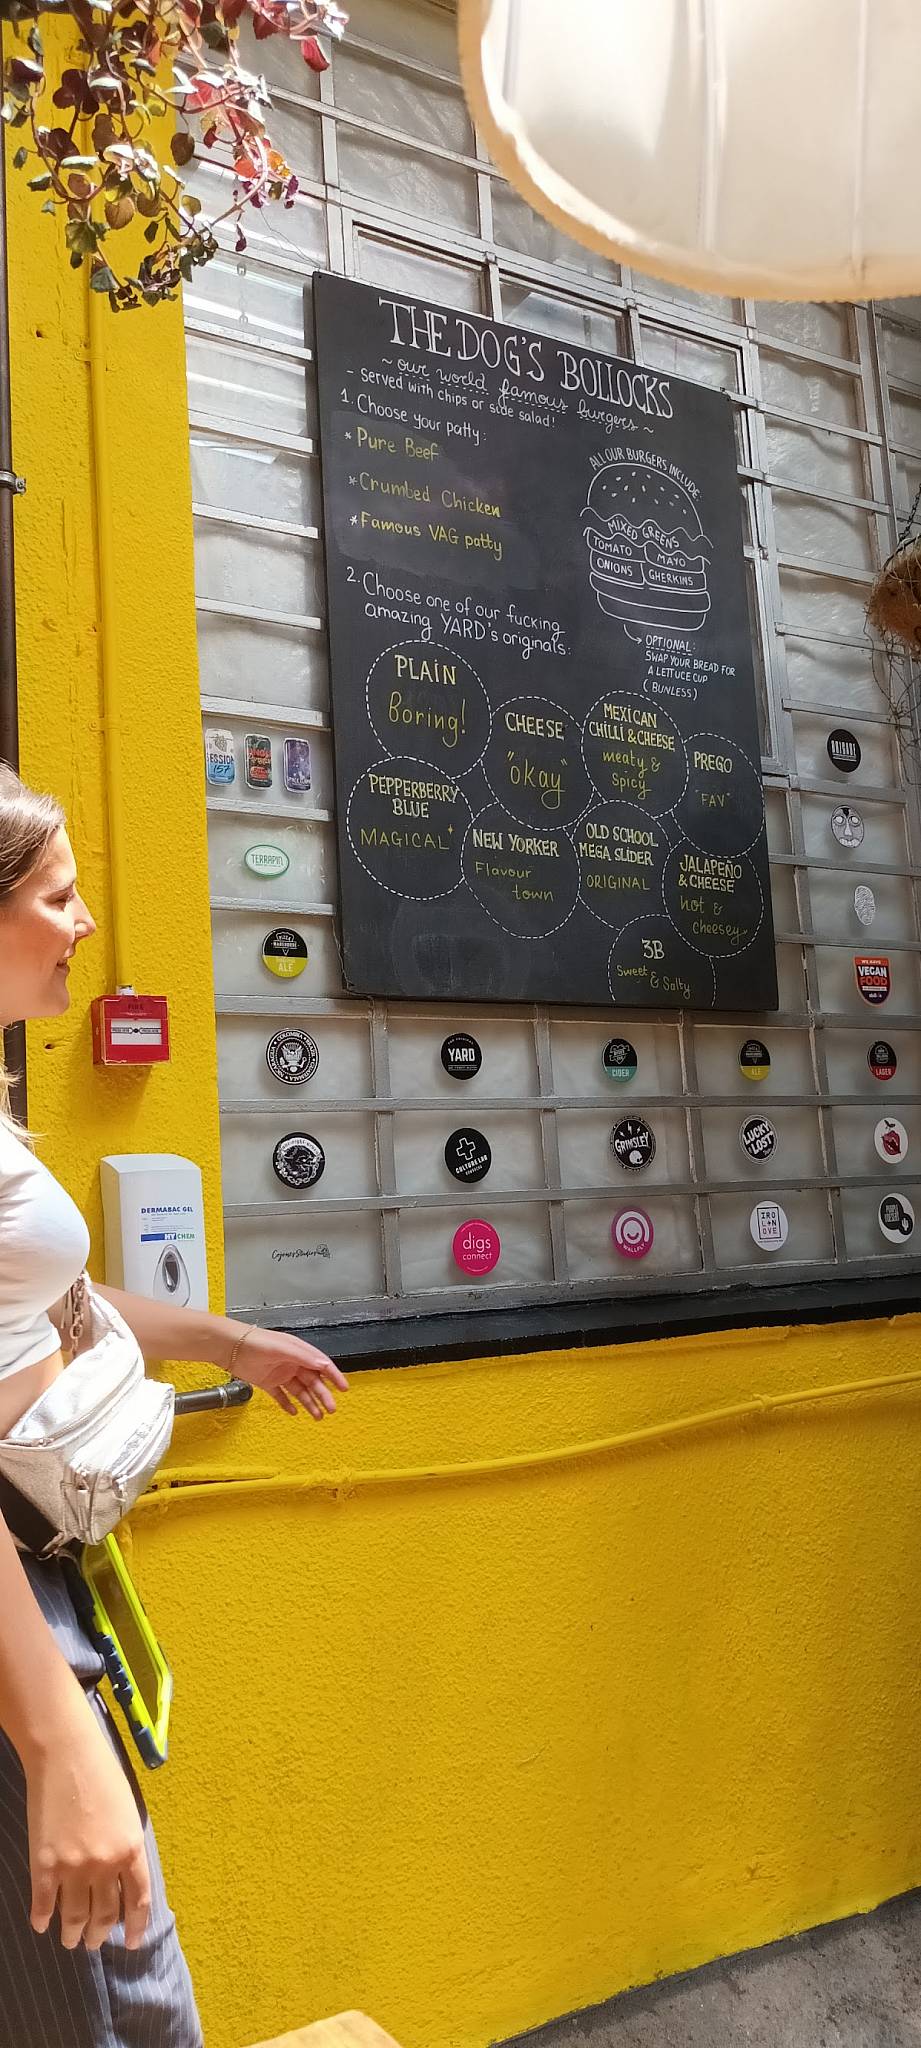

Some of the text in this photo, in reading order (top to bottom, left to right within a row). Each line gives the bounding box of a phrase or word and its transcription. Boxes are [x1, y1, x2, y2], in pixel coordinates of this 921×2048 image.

[378, 297, 674, 418] THE DOG'S BOLLOCKS
[397, 358, 639, 434] our world famous burgers
[408, 381, 434, 399] with
[437, 389, 468, 407] chips
[472, 399, 484, 410] or
[518, 410, 556, 428] salad!
[357, 393, 409, 423] Choose
[413, 412, 442, 432] your
[446, 421, 487, 446] patty:
[356, 426, 441, 462] Pure Beef
[589, 452, 606, 471] ALL
[605, 448, 626, 462] OUR
[627, 448, 668, 471] BURGERS
[359, 473, 501, 518] Crumbed Chicken
[360, 513, 503, 560] Famous VAG patty
[593, 536, 632, 557] TOMATO
[642, 527, 680, 549] GREENS
[597, 557, 633, 577] ONIONS
[656, 553, 686, 568] MAYO
[649, 569, 693, 586] GHERKINS
[346, 566, 565, 639] 2. Choose one of our fucking
[365, 602, 432, 641] amazing
[503, 632, 571, 660] originals:
[645, 651, 736, 676] SWAP YOUR BREAD FOR
[647, 664, 708, 684] A LETTUCE CUP
[388, 691, 466, 748] Boring!
[505, 712, 565, 740] CHEESE
[213, 765, 230, 775] 157
[603, 750, 661, 779] meaty &
[694, 751, 733, 774] PREGO
[369, 774, 459, 804] PEPPERBERRY
[392, 798, 429, 819] BLUE
[360, 828, 449, 850] MAGICAL
[473, 829, 560, 858] NEW YORKER
[586, 822, 659, 848] OLD SCHOOL
[251, 854, 284, 866] TERRAPIN
[579, 842, 611, 861] MEGA
[475, 861, 532, 879] Flavour
[679, 854, 742, 879] JALAPEÑO
[512, 884, 554, 901] town
[586, 874, 650, 891] ORIGINAL
[641, 938, 665, 960] 3B
[650, 971, 660, 989] &
[858, 966, 888, 978] VEGAN
[860, 977, 888, 986] FOOD
[448, 1048, 476, 1062] YARD
[612, 1068, 630, 1077] CIDER
[875, 1068, 893, 1076] LAGER
[614, 1131, 649, 1155] GRIMSLEY
[743, 1121, 770, 1146] LUCKY
[755, 1131, 774, 1154] LOST
[455, 1158, 478, 1174] CULTURE
[141, 1206, 180, 1214] DERMABAC
[462, 1232, 491, 1253] digs
[462, 1252, 492, 1261] connect
